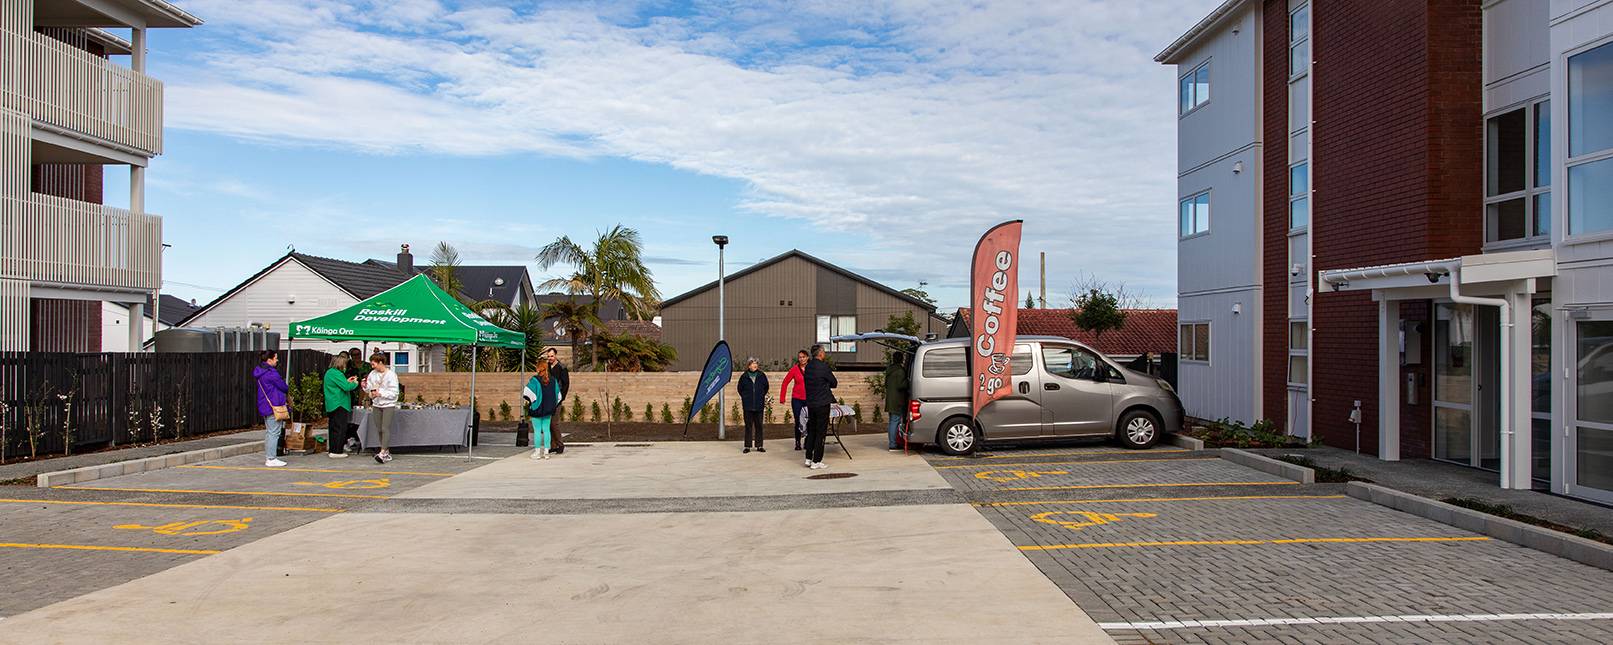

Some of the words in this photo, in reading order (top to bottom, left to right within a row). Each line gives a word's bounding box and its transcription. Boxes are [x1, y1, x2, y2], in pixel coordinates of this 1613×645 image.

[977, 251, 1012, 357] Coffee
[359, 308, 408, 316] Roskill
[353, 315, 447, 325] Development
[338, 327, 354, 336] Ora
[987, 377, 1002, 395] go
